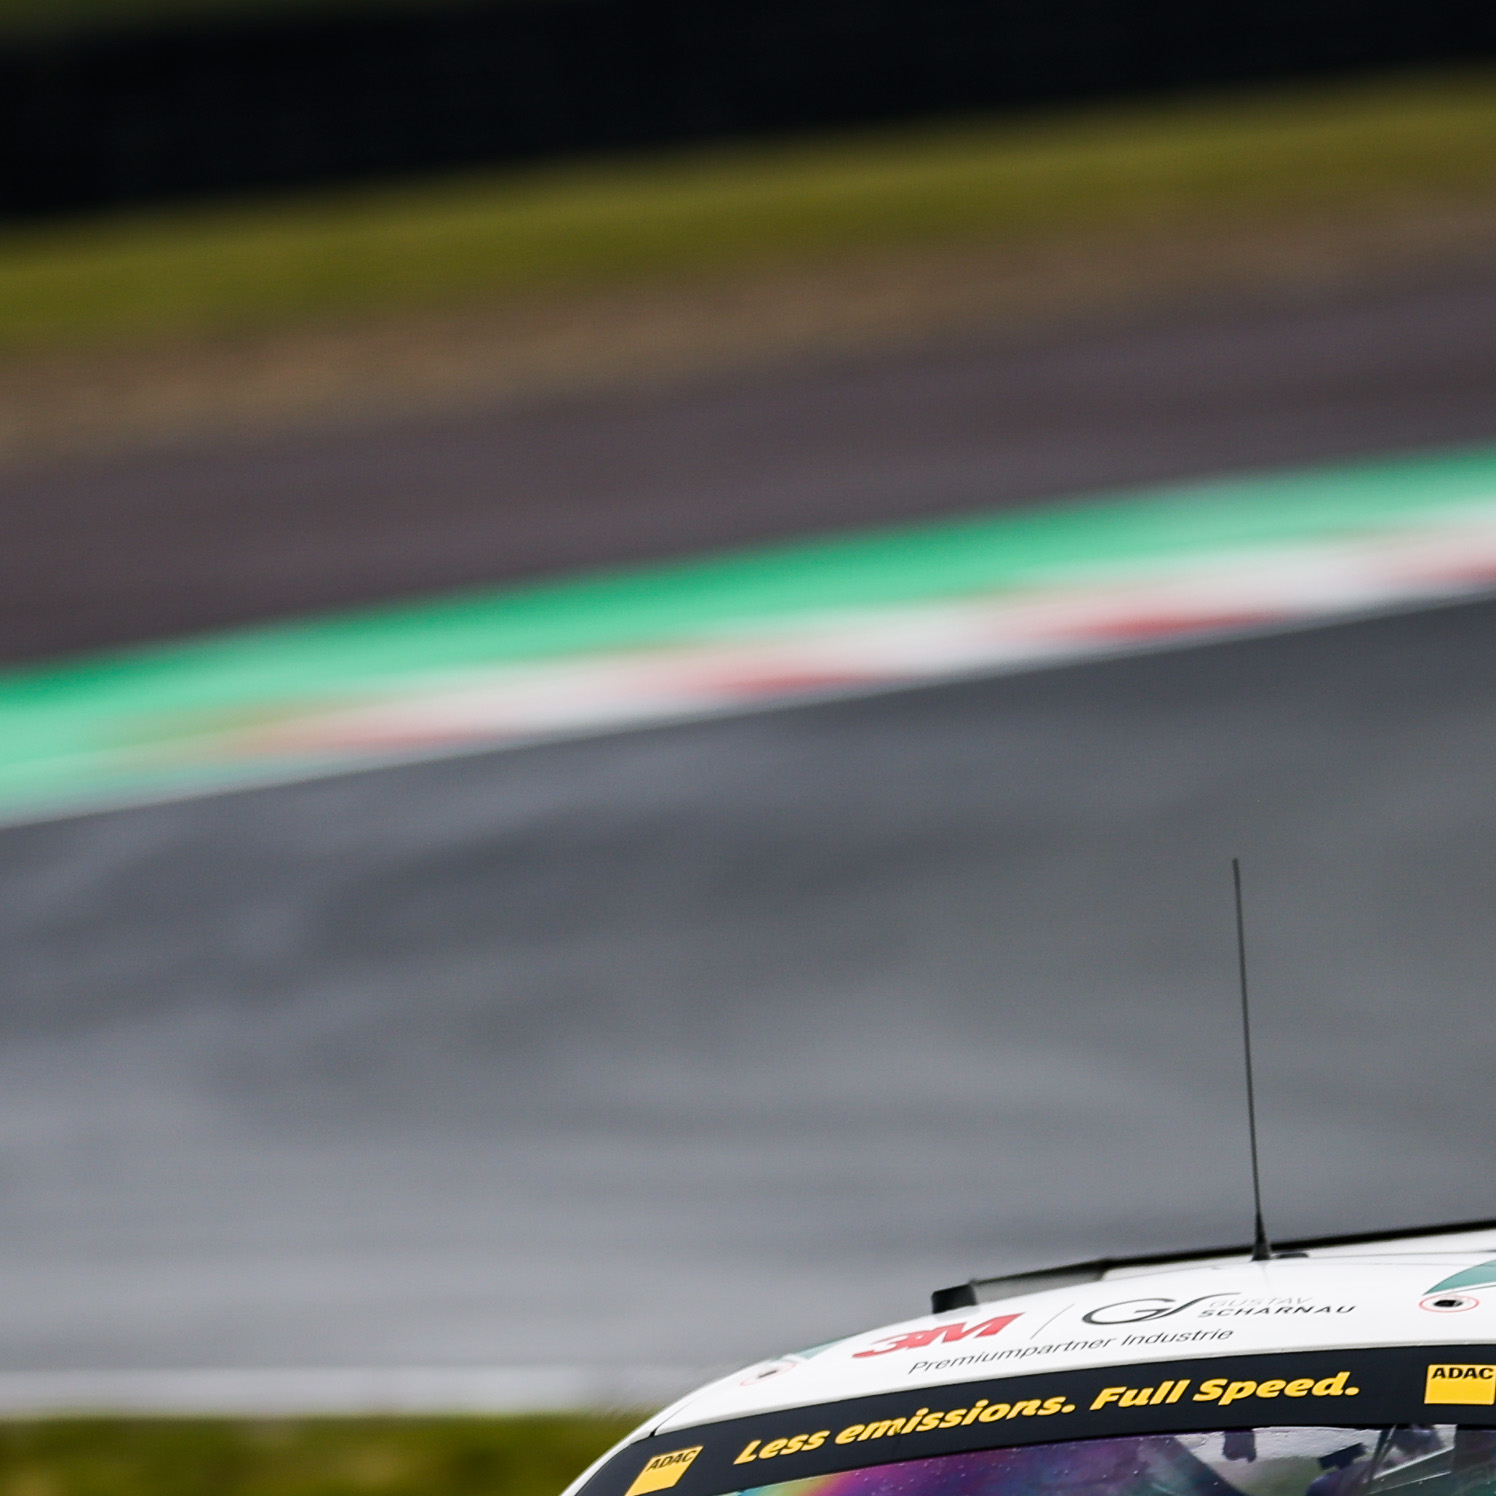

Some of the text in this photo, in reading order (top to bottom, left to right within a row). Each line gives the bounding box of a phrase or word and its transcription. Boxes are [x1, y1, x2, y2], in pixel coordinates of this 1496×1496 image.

[1197, 1304, 1357, 1319] SCHARNAU
[1207, 1296, 1312, 1308] GUSTAV
[851, 1311, 1027, 1360] 3M
[907, 1326, 1235, 1375] Premiumpartner Industrie
[1432, 1367, 1494, 1380] ADAC
[733, 1371, 1361, 1465] Less emissions. Full Speed.
[645, 1449, 697, 1472] ADAC
